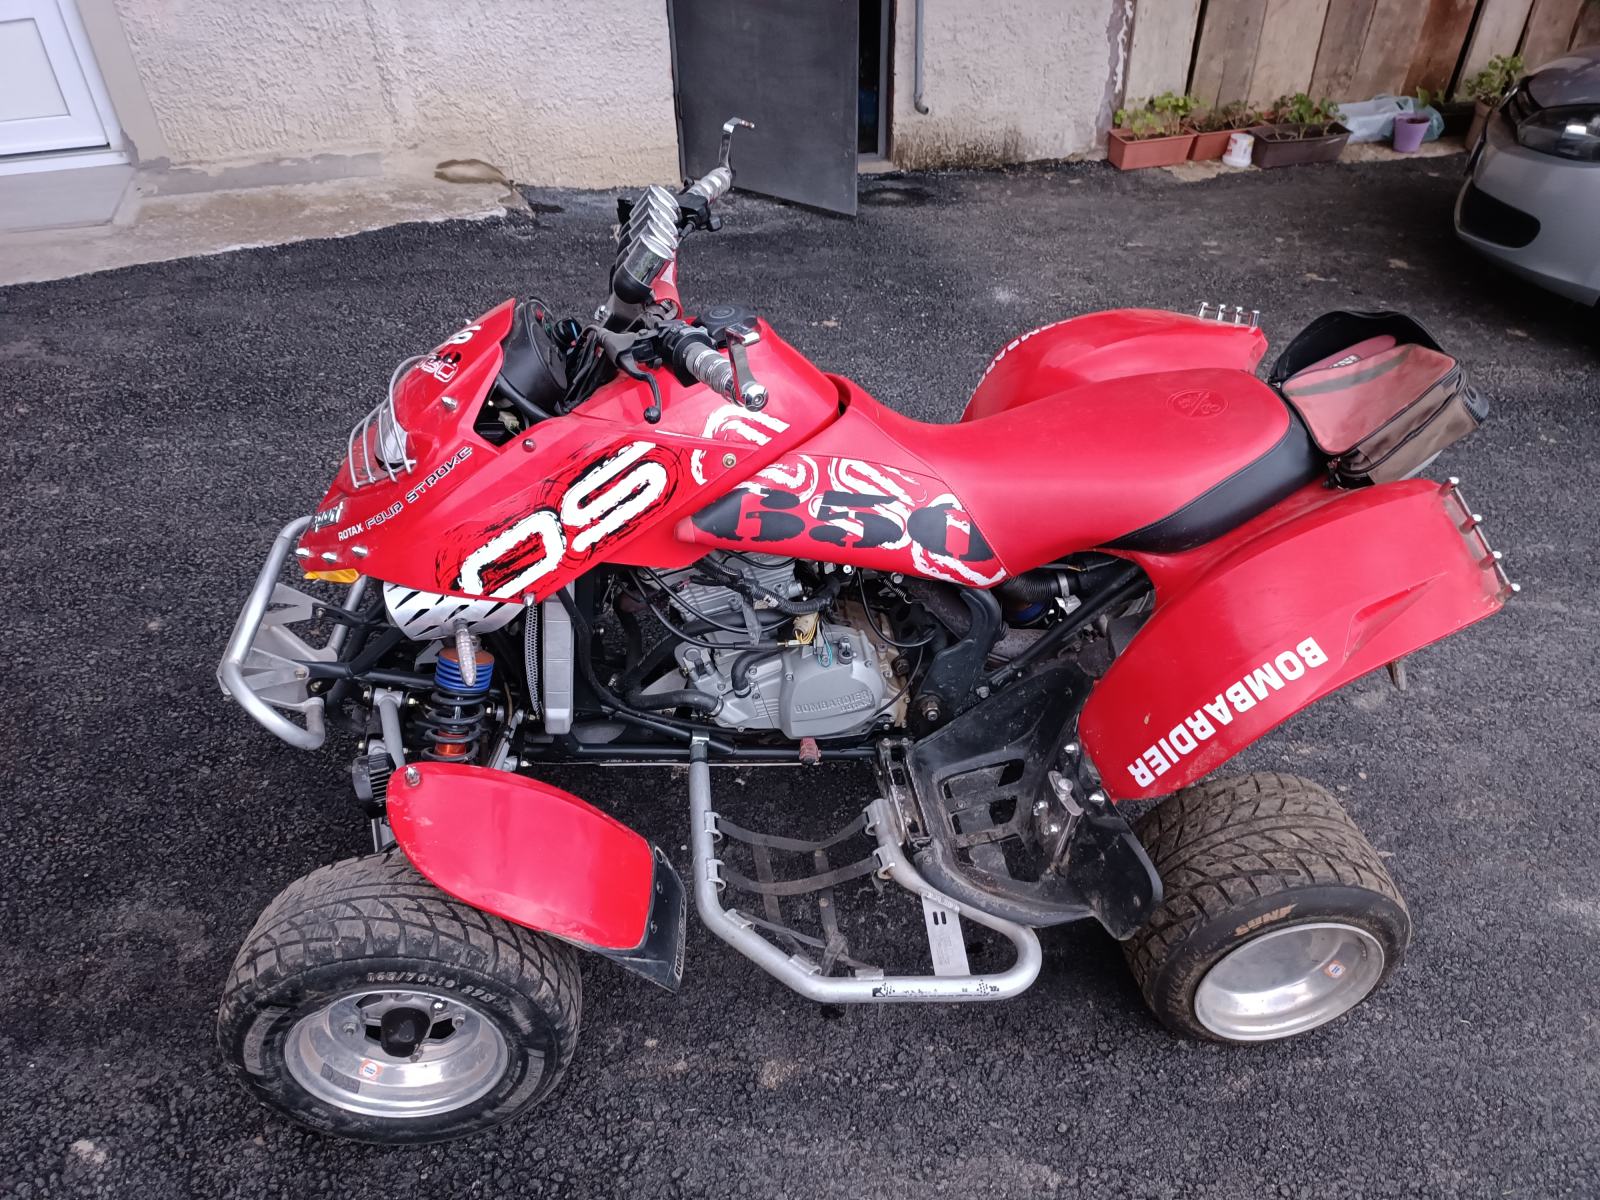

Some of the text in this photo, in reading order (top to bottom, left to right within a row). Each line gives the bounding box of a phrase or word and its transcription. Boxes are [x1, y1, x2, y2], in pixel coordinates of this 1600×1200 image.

[337, 523, 364, 541] ROTAX
[365, 501, 404, 530] FOUR
[405, 446, 473, 504] STROKE
[458, 440, 669, 598] DS
[1127, 636, 1329, 788] BOMBARDIER
